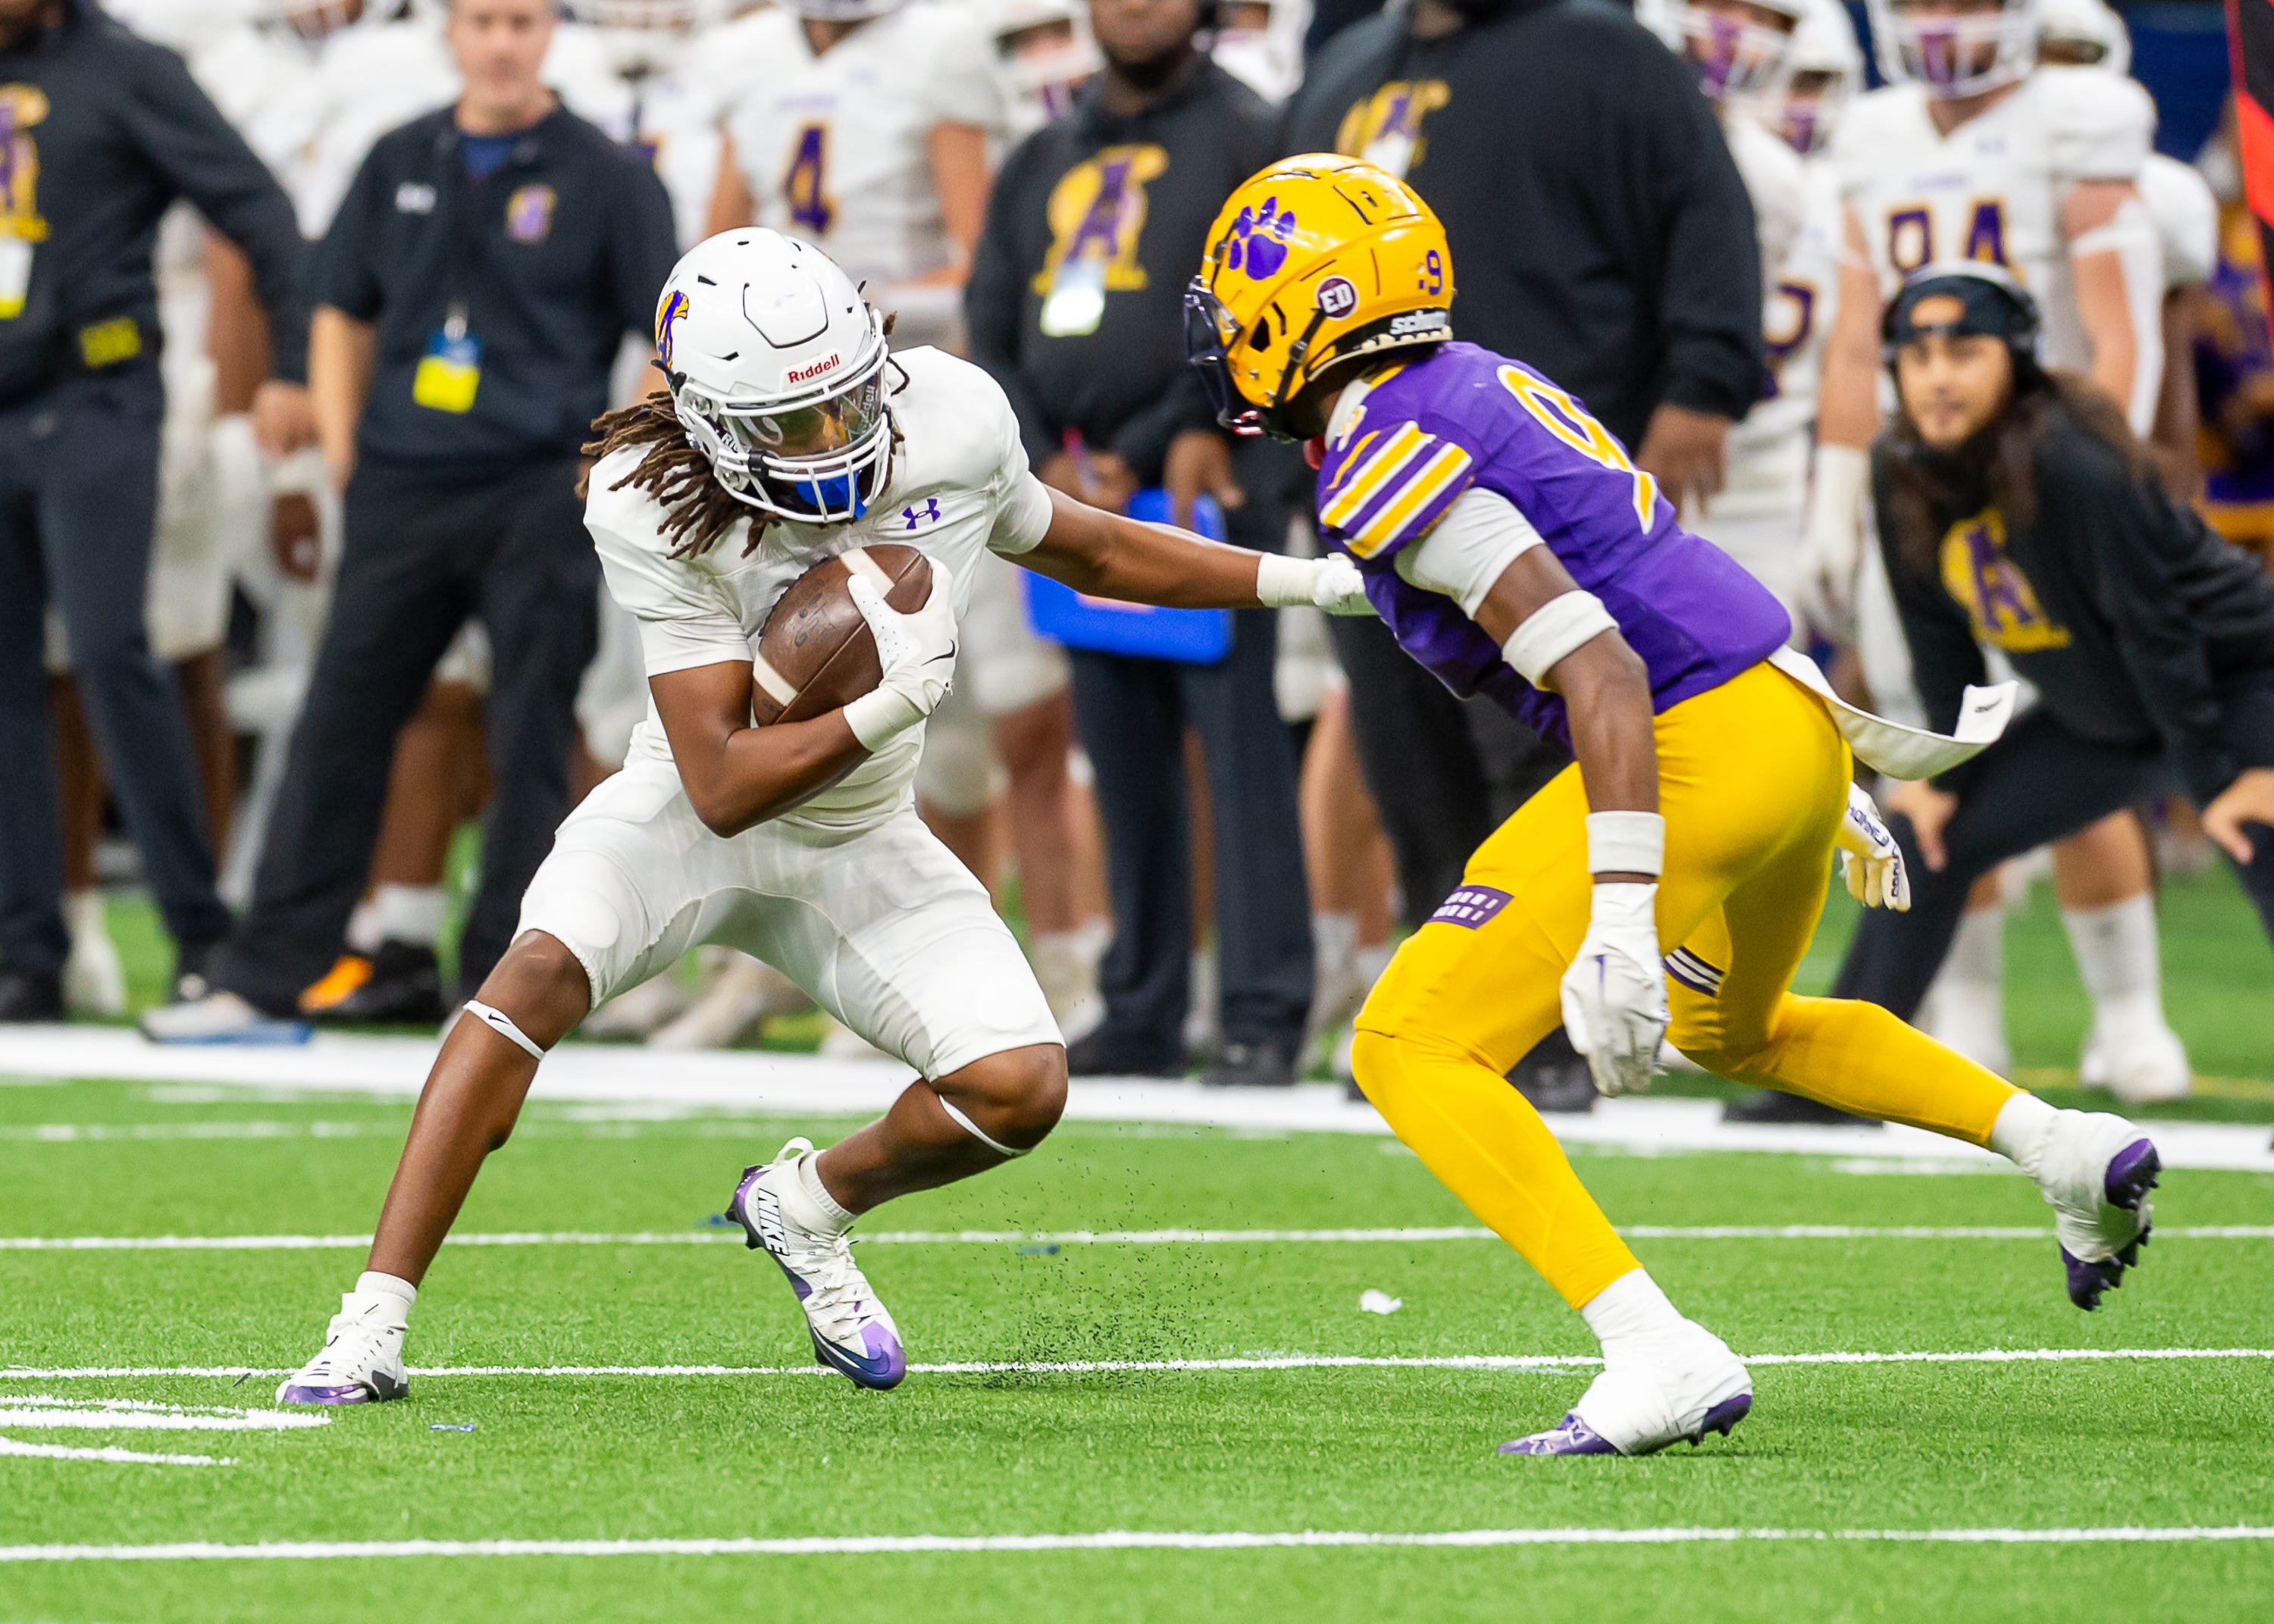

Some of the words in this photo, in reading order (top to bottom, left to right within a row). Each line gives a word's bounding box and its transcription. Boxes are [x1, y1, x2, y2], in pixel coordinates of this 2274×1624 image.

[783, 123, 837, 233] 4
[1319, 283, 1354, 314] ED
[1427, 249, 1443, 296] 9
[787, 353, 841, 384] Riddell
[1496, 364, 1659, 535] 9
[758, 1187, 791, 1256] NIKE
